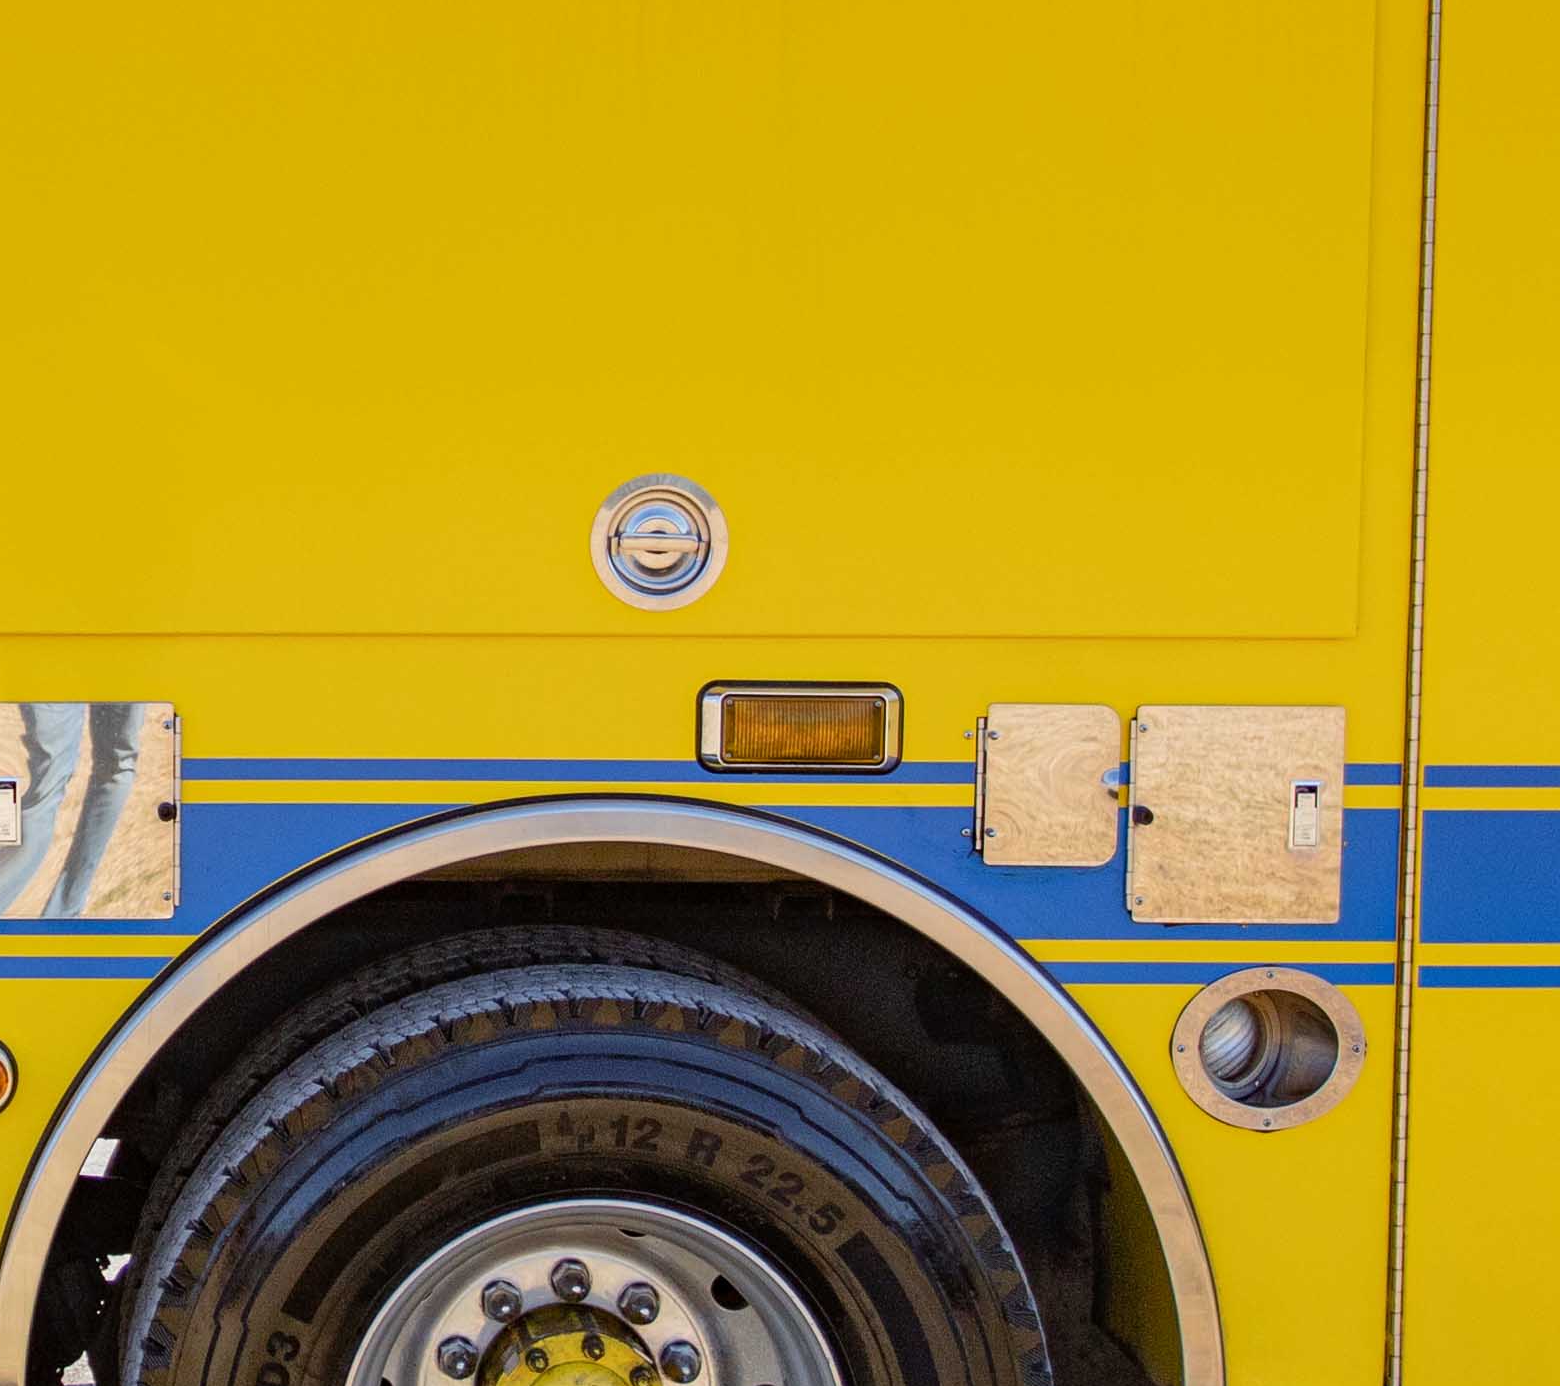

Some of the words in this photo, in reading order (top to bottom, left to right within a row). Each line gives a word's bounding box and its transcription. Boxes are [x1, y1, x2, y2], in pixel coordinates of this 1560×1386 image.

[611, 1115, 663, 1152] 12
[686, 1128, 724, 1167] R
[738, 1153, 846, 1236] 22.5
